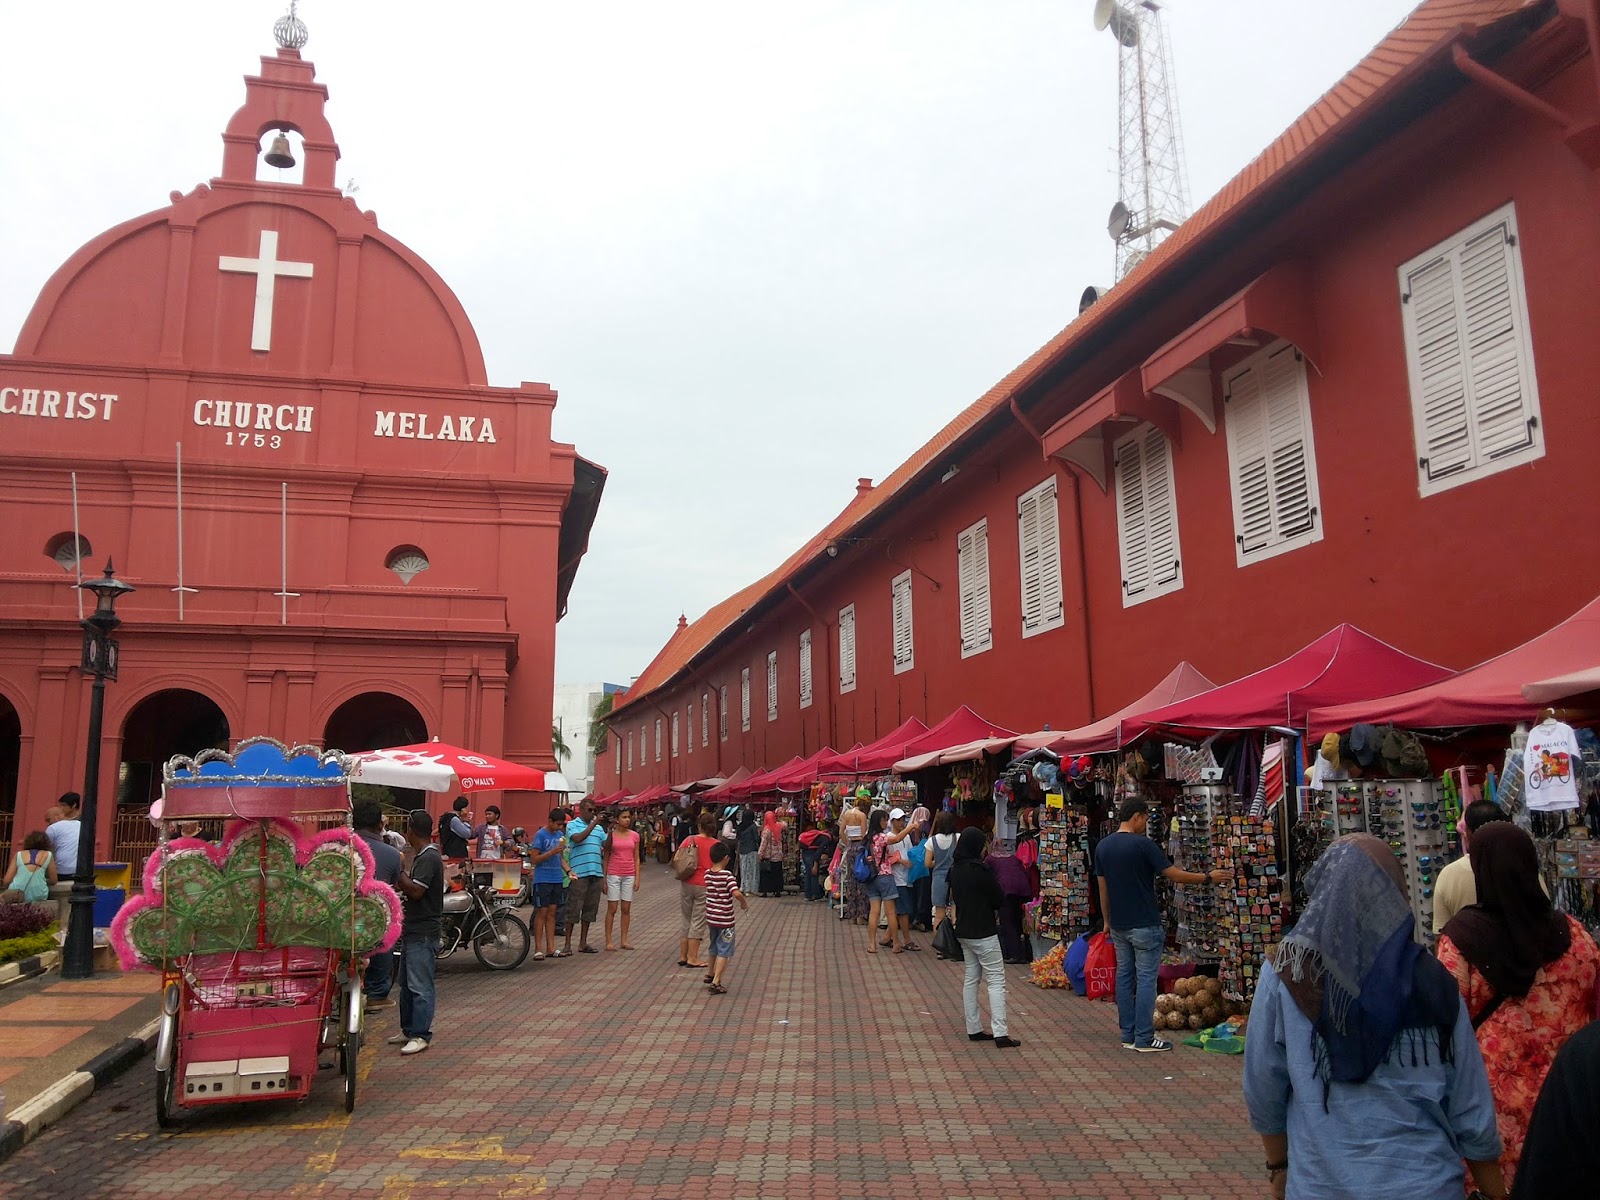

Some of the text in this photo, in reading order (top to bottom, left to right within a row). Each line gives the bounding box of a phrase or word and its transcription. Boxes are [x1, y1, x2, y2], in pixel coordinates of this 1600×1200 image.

[0, 387, 497, 443] CHRIST CHURCH MELAKA
[225, 431, 282, 449] 1753
[1090, 980, 1111, 992] ON
